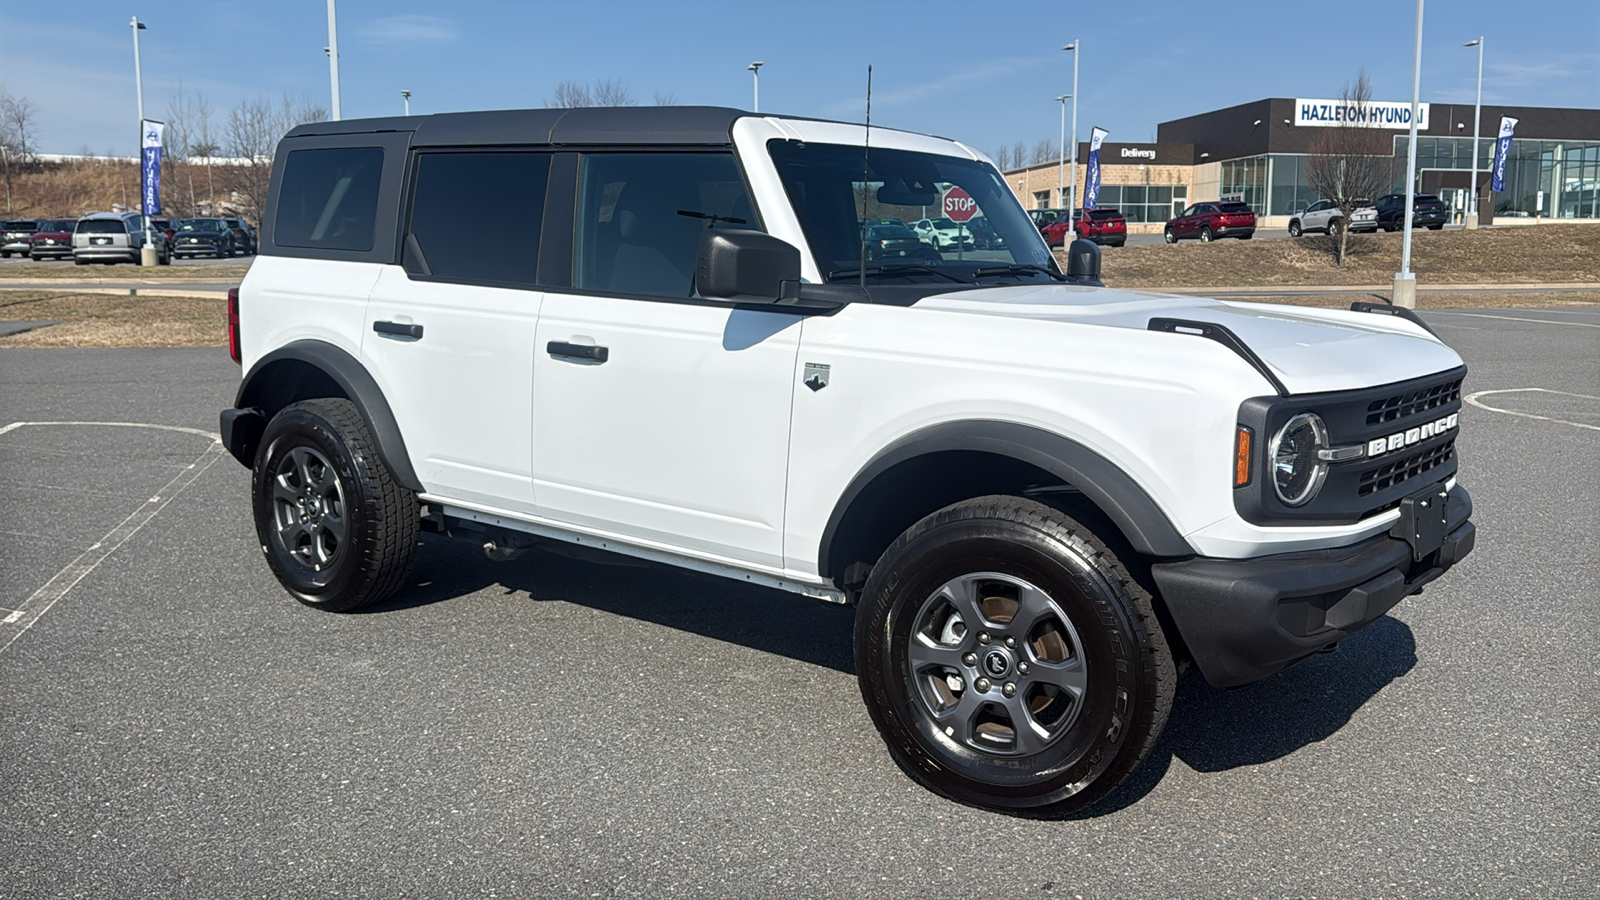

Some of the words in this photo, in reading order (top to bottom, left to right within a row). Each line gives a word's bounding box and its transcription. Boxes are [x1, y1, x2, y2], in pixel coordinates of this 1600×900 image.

[1301, 104, 1367, 122] HAZLETON
[1369, 107, 1423, 124] HYUNDI
[1121, 148, 1156, 160] Delivery
[146, 150, 155, 214] HYUNDAI
[945, 197, 976, 212] STOP
[1368, 413, 1459, 457] BRONCO
